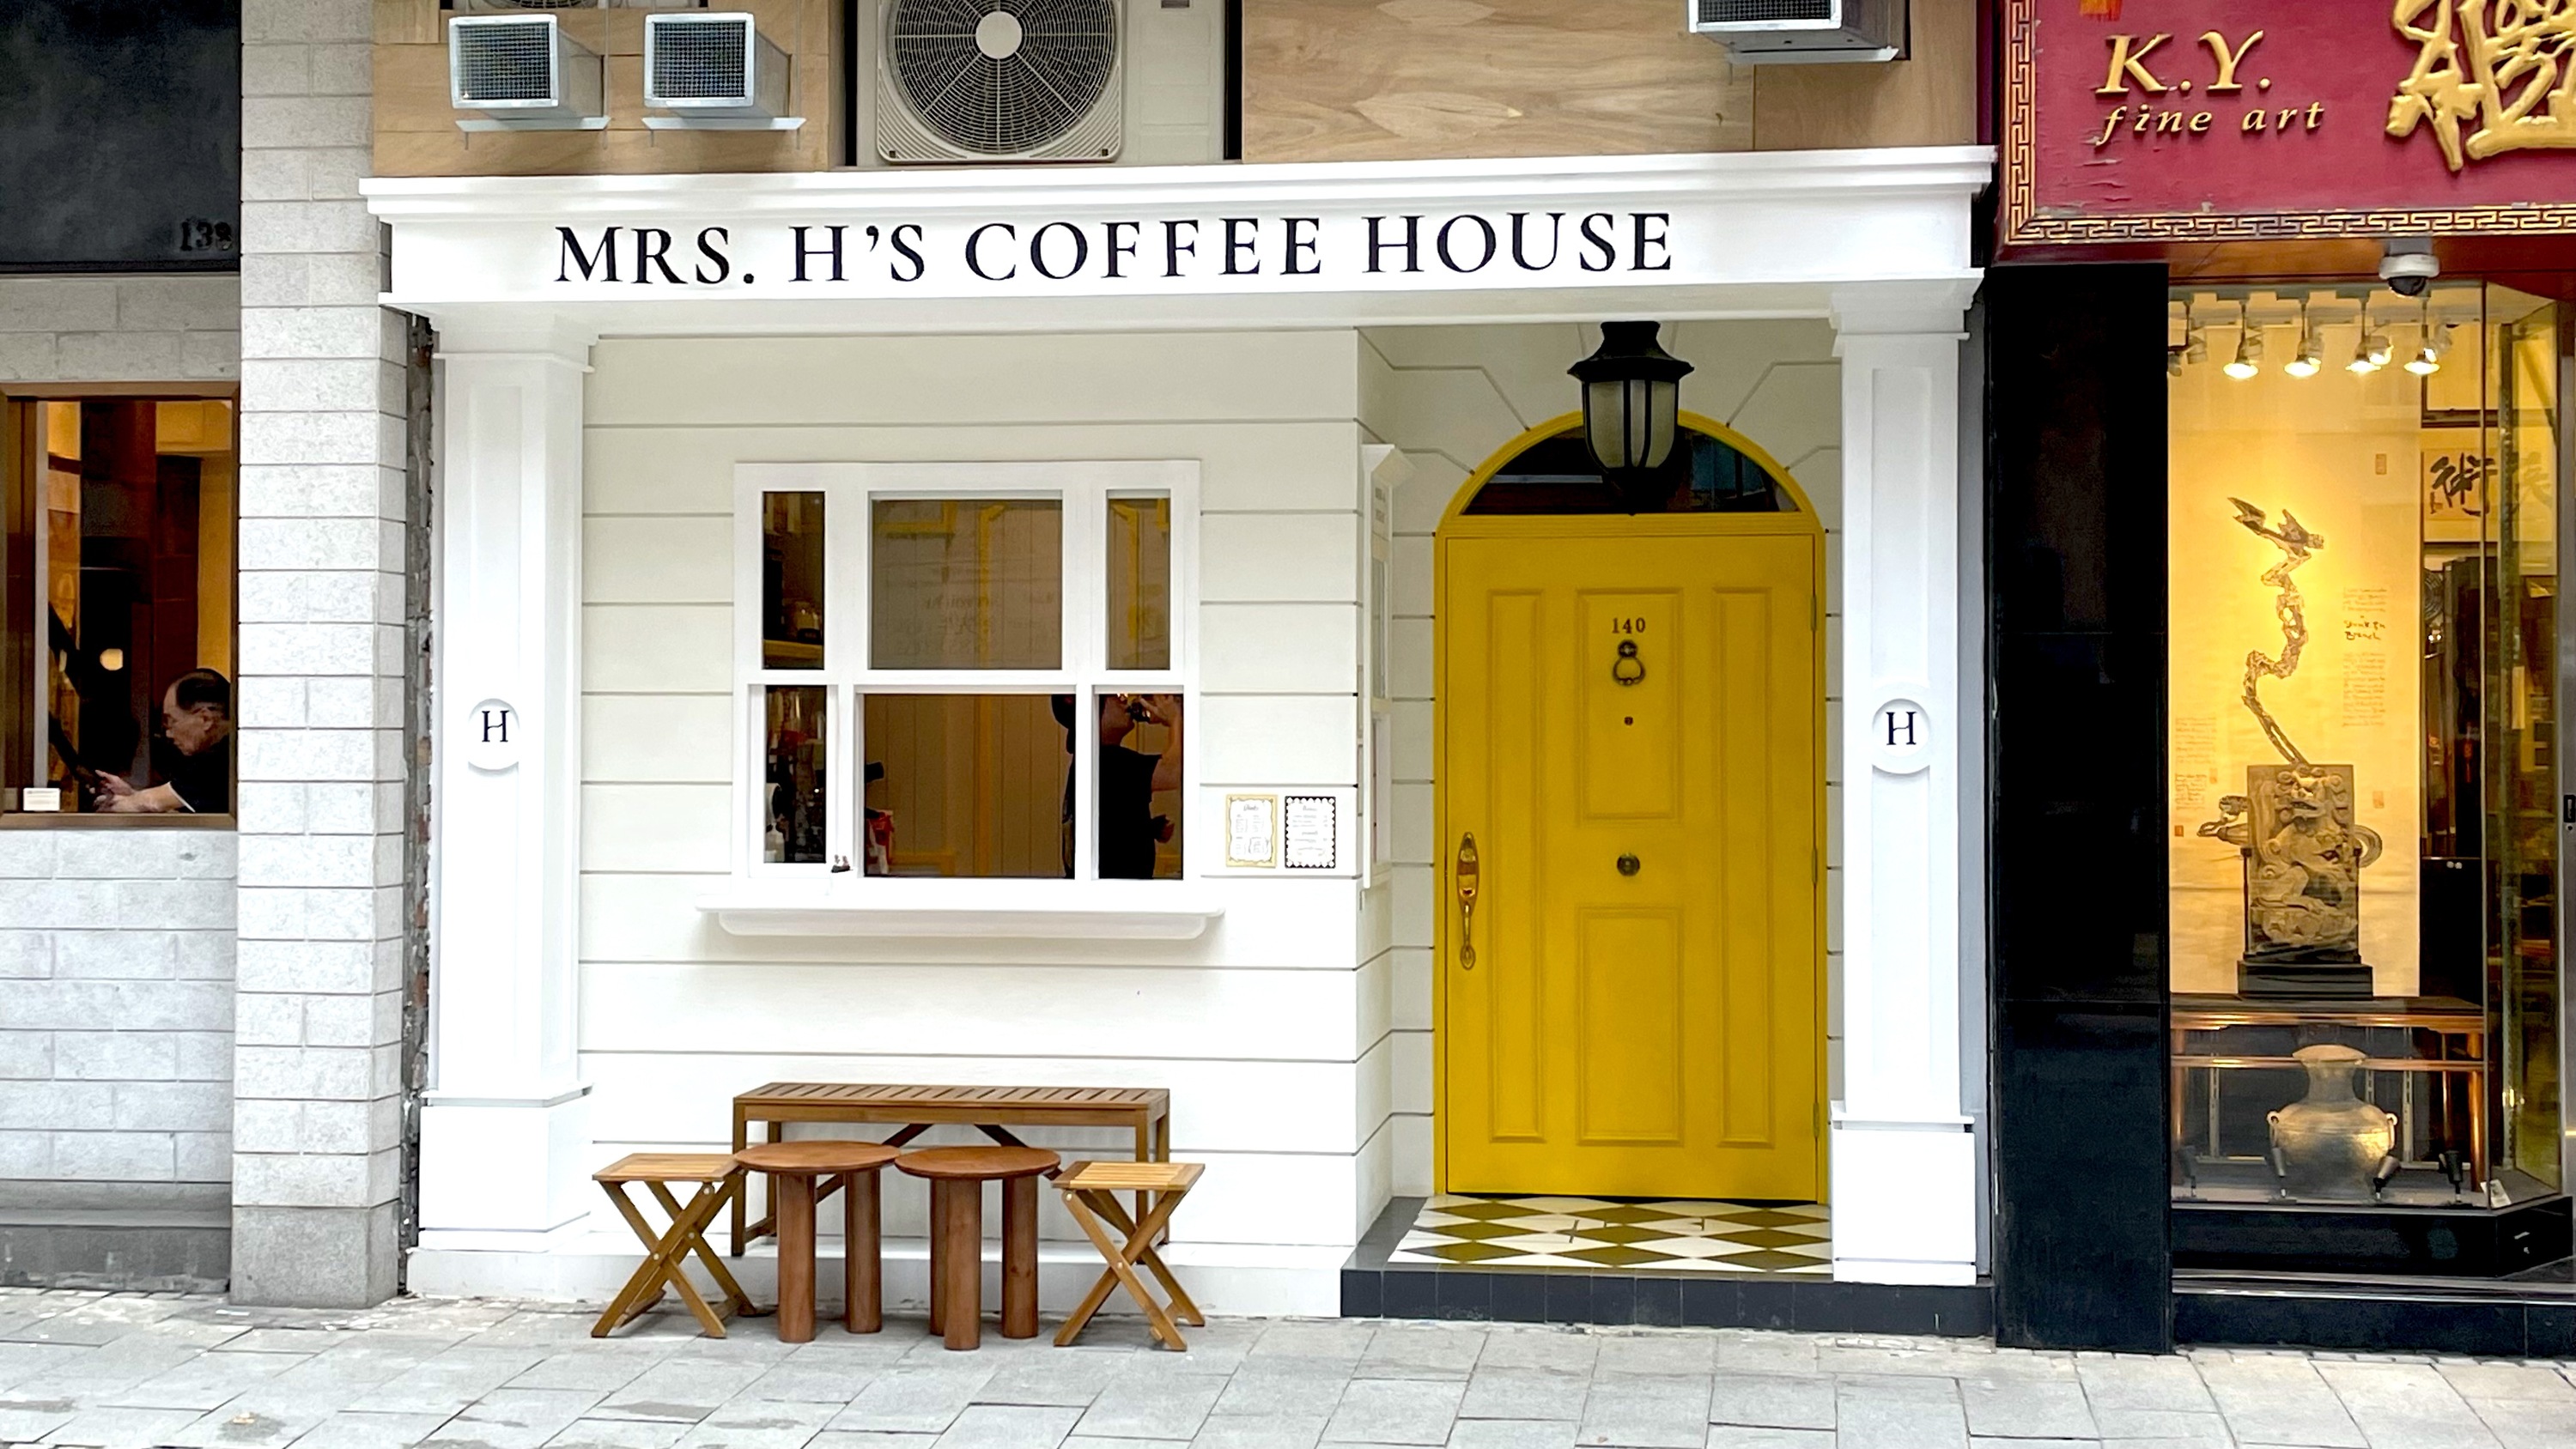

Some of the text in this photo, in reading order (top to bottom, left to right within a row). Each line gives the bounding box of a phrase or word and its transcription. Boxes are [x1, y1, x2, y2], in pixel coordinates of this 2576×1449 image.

[2095, 30, 2272, 94] K.Y.
[2095, 101, 2325, 146] fine art
[554, 211, 1672, 285] MRS. H'S COFFEE HOUSE
[1612, 617, 1646, 634] 140
[481, 710, 510, 743] H
[1886, 711, 1917, 746] H
